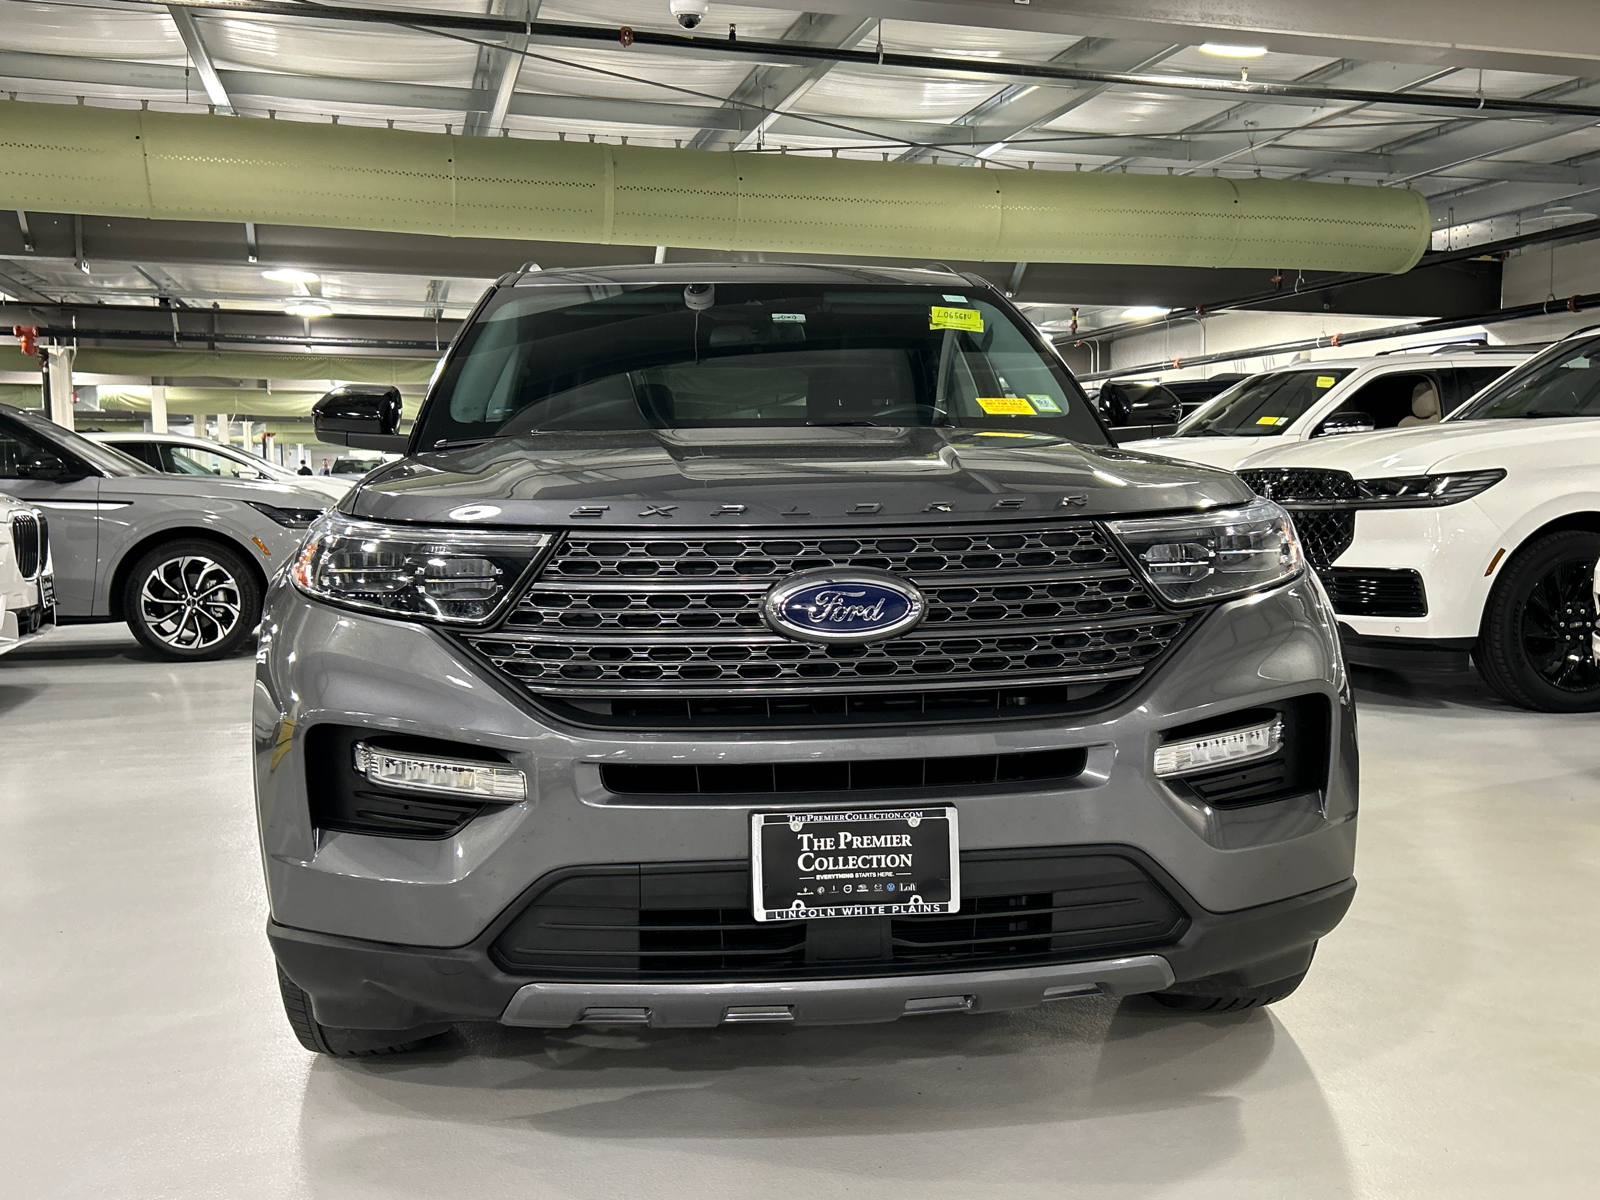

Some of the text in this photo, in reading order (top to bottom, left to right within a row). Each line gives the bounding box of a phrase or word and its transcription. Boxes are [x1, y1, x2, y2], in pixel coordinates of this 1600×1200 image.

[569, 494, 1088, 517] EXPLORER
[808, 590, 885, 622] Ford
[797, 831, 912, 852] THE PREMIER
[797, 852, 912, 872] COLLECTION
[775, 903, 941, 919] LINCOLN WHITE PLAINS
